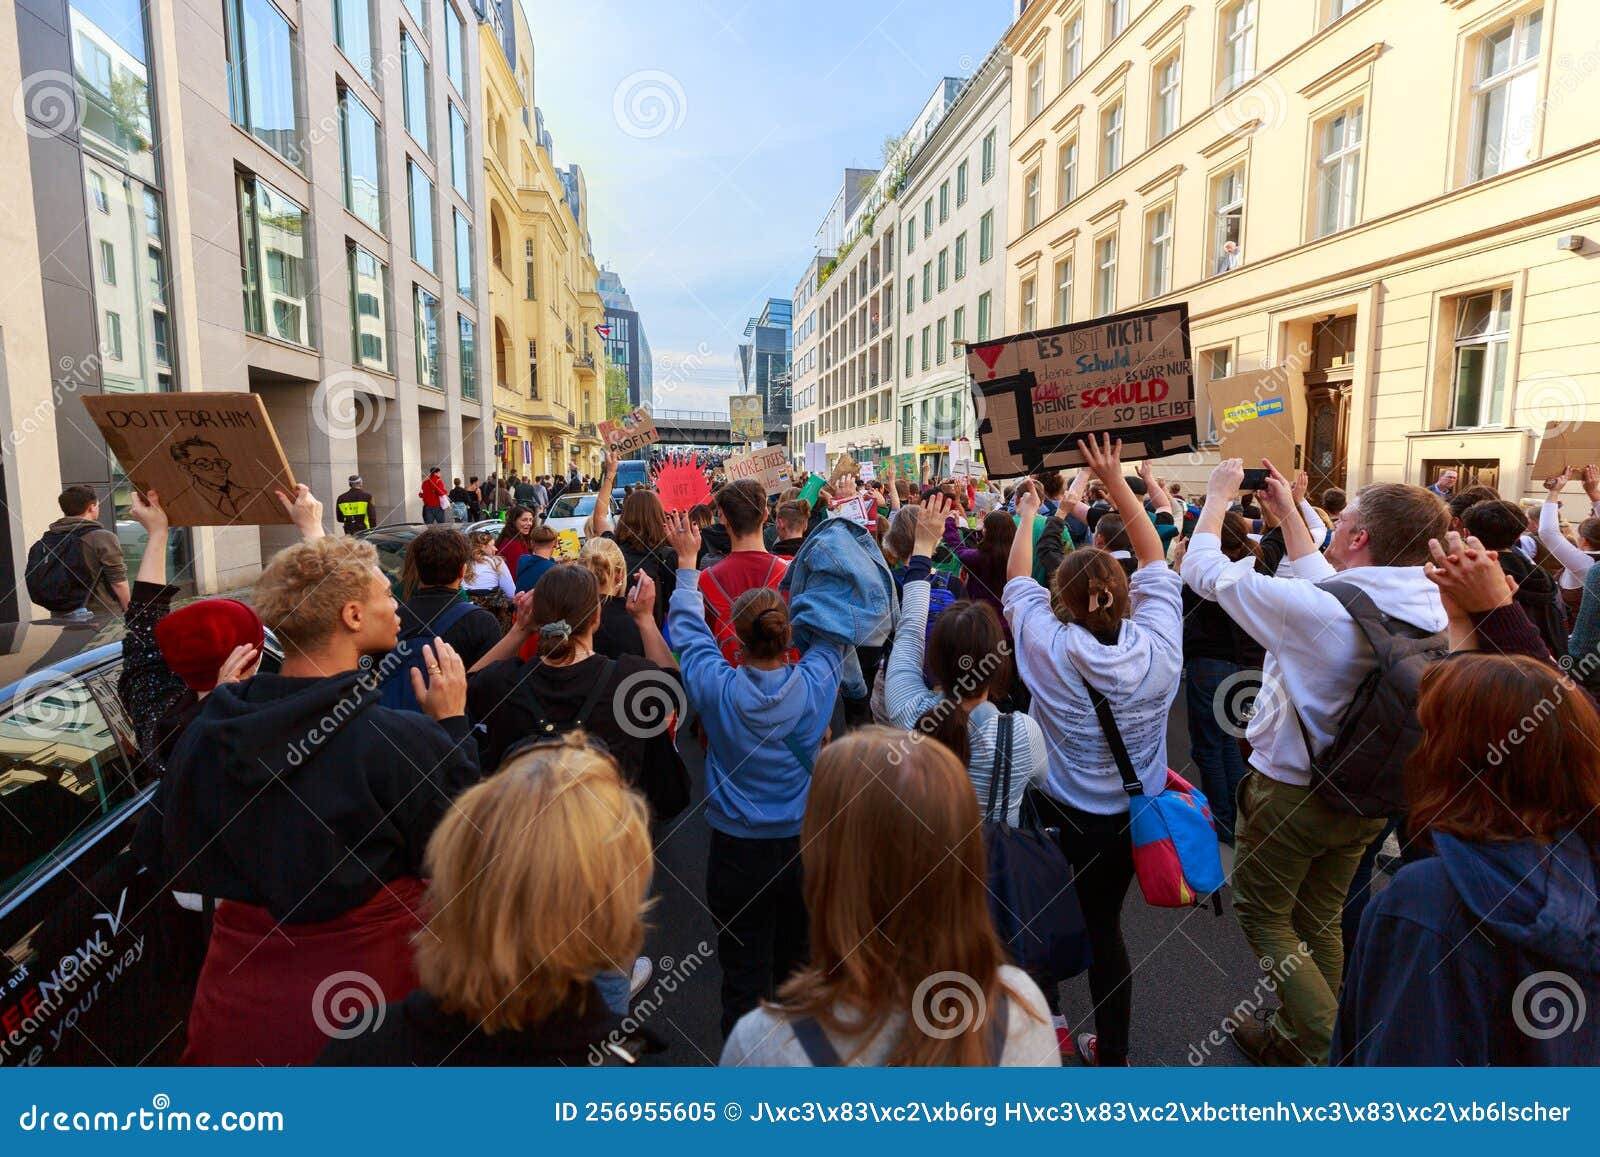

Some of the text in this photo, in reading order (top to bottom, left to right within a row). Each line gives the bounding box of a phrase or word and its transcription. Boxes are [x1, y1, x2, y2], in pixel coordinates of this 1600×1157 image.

[1037, 316, 1157, 359] ES IST NICHT
[1167, 360, 1192, 376] NUR
[1032, 378, 1169, 414] DEINE SCHULD
[106, 409, 257, 429] DO IT FOR HIM
[1038, 412, 1075, 432] WENN
[1113, 406, 1136, 423] SO
[1139, 400, 1194, 421] BLEIBT
[729, 450, 786, 480] MORE TREES
